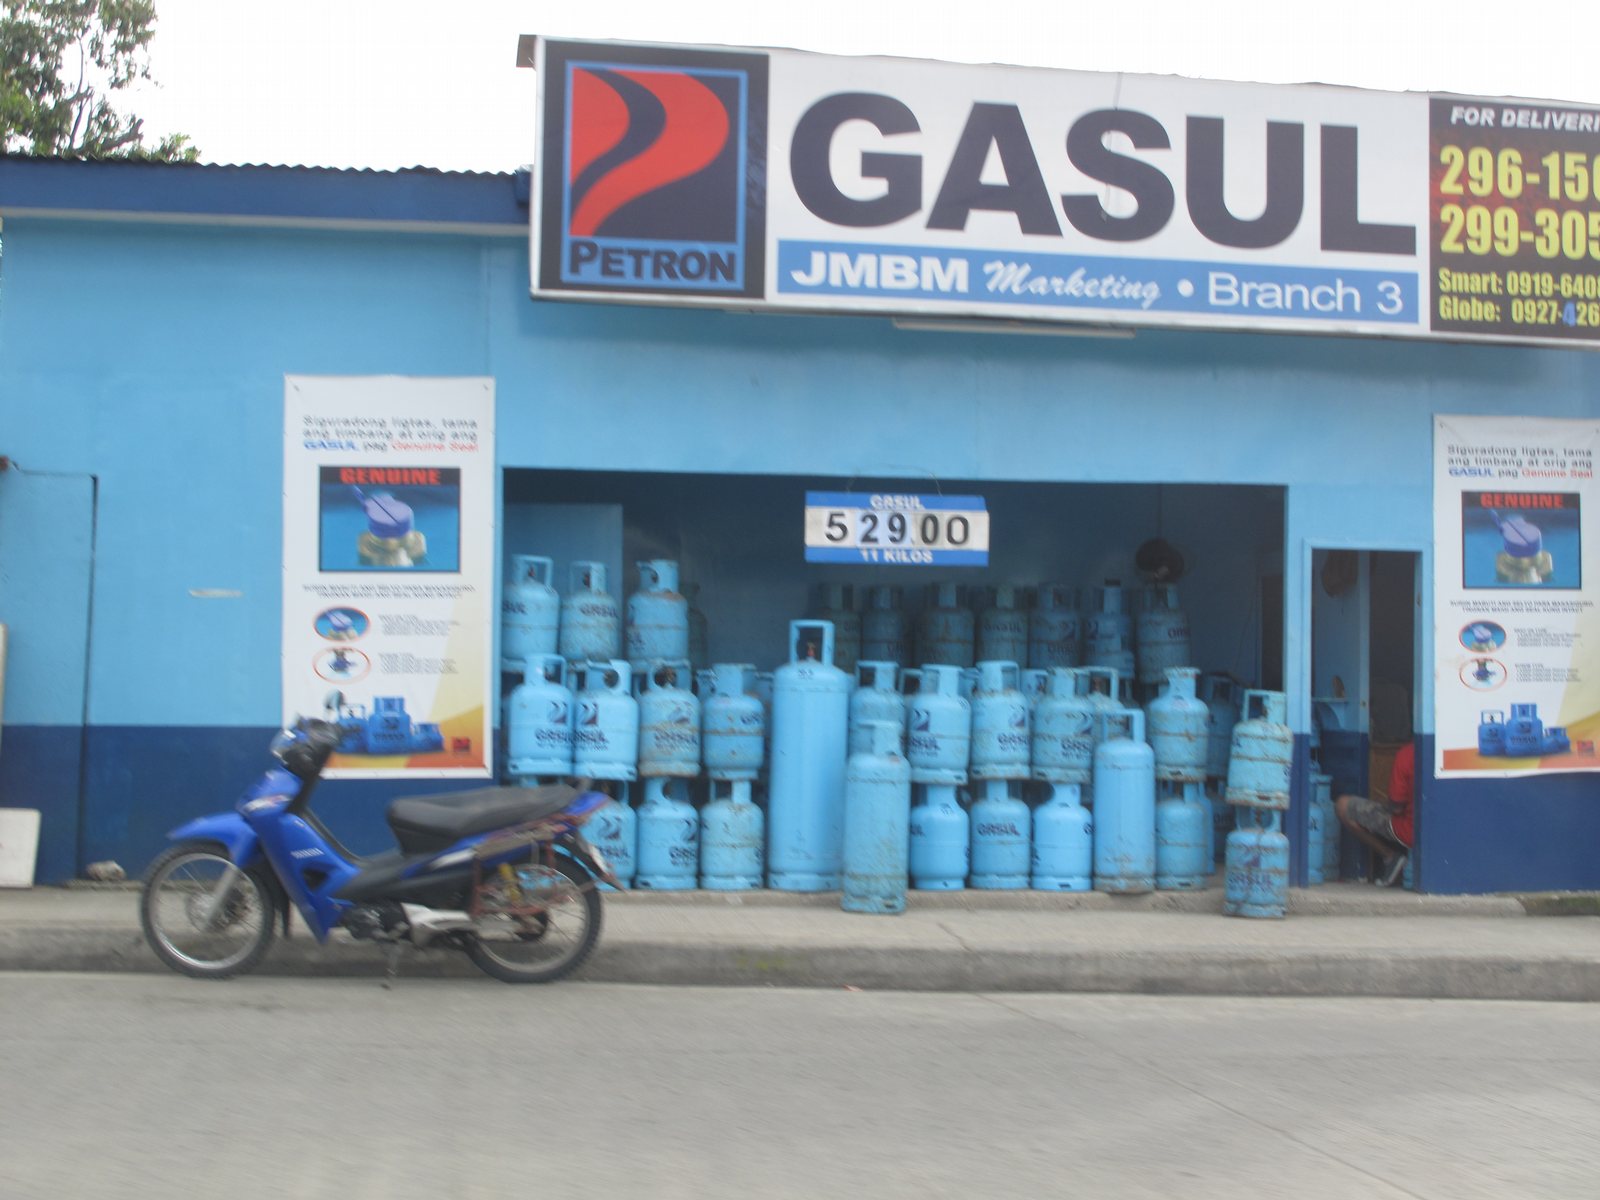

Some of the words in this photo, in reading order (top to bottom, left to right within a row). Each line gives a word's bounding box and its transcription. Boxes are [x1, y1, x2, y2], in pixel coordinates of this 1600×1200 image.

[1451, 105, 1495, 127] FOR
[789, 90, 1416, 256] GASUL
[569, 240, 737, 283] PETRON
[790, 251, 969, 293] JMBM
[982, 259, 1162, 310] Marketing
[1208, 270, 1362, 314] Branch
[1376, 280, 1404, 316] 3
[1438, 267, 1503, 295] Smart:
[1506, 270, 1600, 300] 0919-640
[1438, 294, 1501, 322] Globe:
[339, 467, 442, 485] GENUINE
[1480, 492, 1564, 509] GENUINE
[883, 547, 934, 563] KILOS
